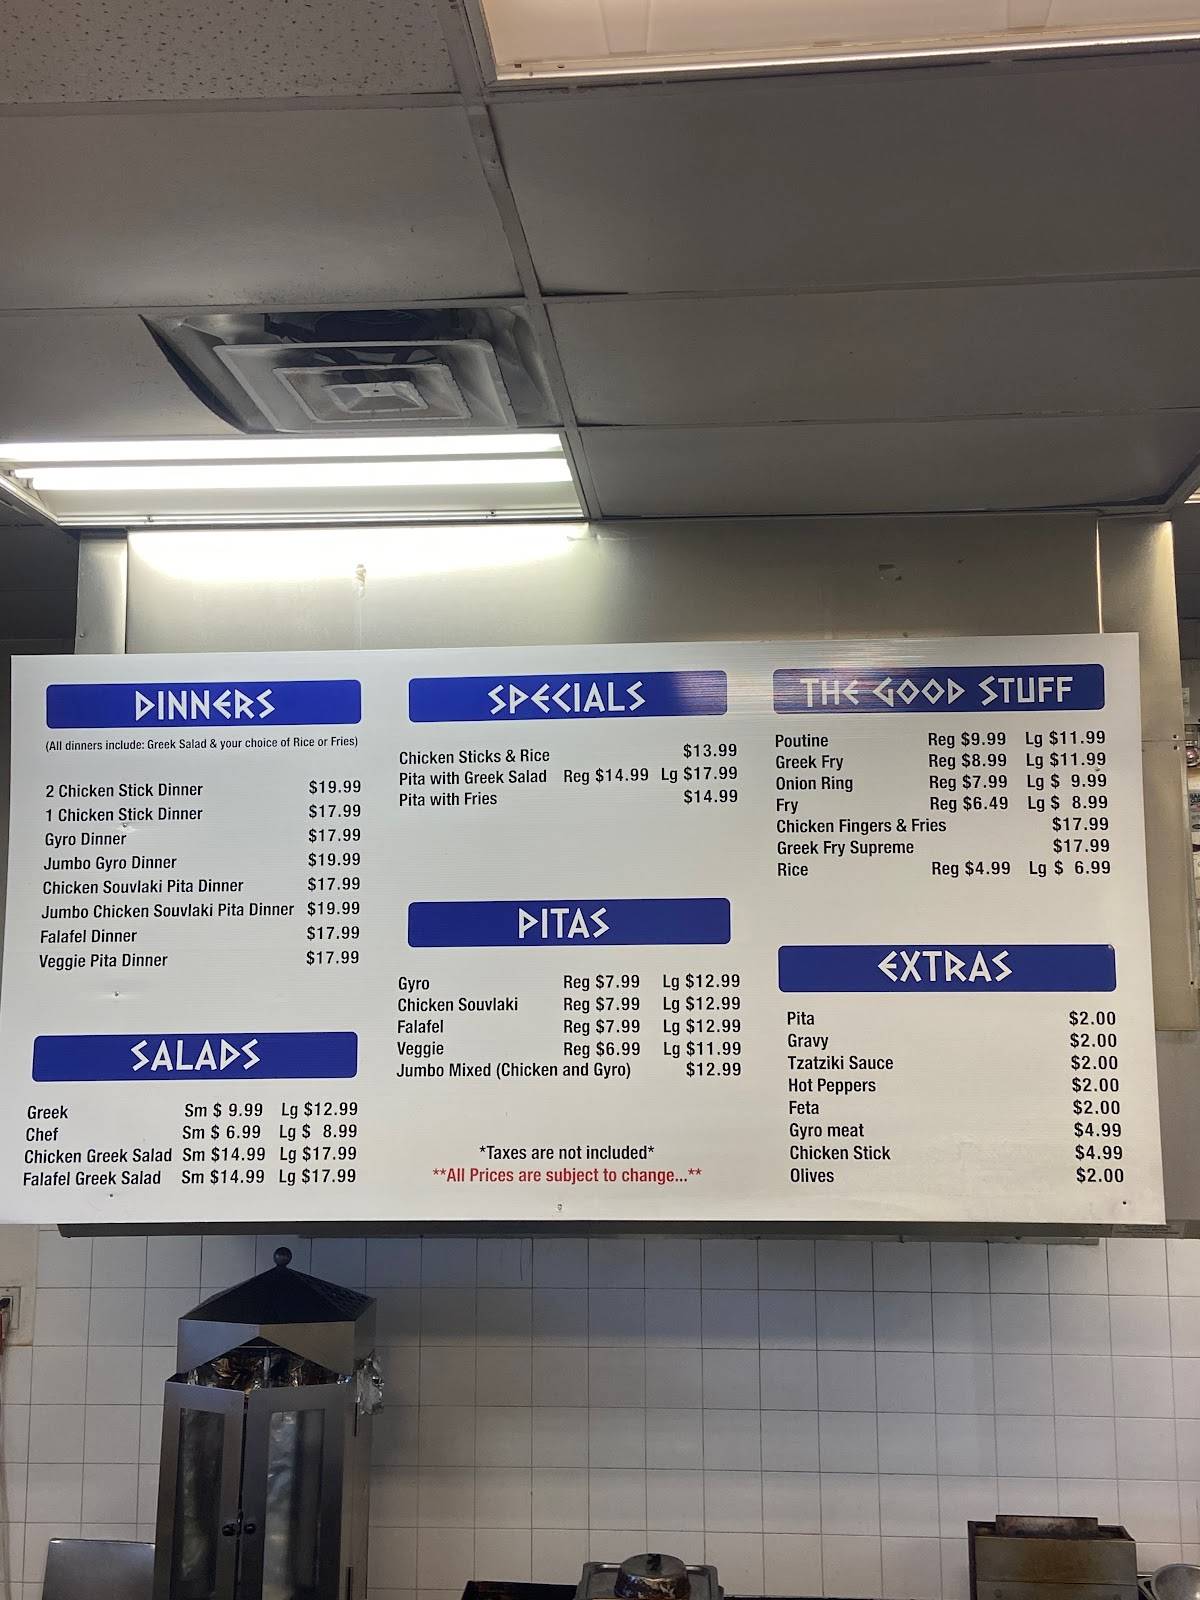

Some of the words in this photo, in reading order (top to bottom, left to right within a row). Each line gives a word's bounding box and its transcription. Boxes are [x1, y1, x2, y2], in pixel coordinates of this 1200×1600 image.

[487, 680, 646, 715] SPECIALS
[799, 676, 861, 709] THE
[872, 675, 967, 708] GOOD
[977, 675, 1075, 707] STUFF
[135, 688, 275, 721] DINNERS
[45, 740, 62, 753] (All
[64, 740, 103, 751] dinners
[105, 739, 144, 750] include:
[146, 738, 176, 750] Greek
[178, 738, 207, 749] Salad
[209, 738, 217, 749] &
[219, 739, 242, 750] your
[244, 737, 277, 748] choice
[280, 737, 290, 747] of
[293, 736, 315, 747] Rice
[317, 738, 328, 747] or
[330, 735, 358, 748] Fries)
[775, 733, 829, 748] Poutine
[927, 732, 955, 749] Reg
[960, 730, 1006, 747] $9.99
[1025, 731, 1043, 748] Lg
[1048, 729, 1105, 746] $11.99
[399, 750, 454, 765] Chicken
[458, 749, 501, 764] Sticks
[505, 748, 516, 763] &
[520, 748, 550, 762] Rice
[683, 742, 737, 759] $13.99
[775, 754, 817, 769] Greek
[821, 754, 844, 771] Fry
[928, 753, 956, 770] Reg
[961, 752, 1007, 768] $8.99
[1026, 752, 1043, 770] Lg
[1049, 751, 1106, 768] $11.99
[399, 772, 425, 786] Pita
[429, 770, 459, 785] with
[464, 770, 504, 784] Greek
[508, 769, 547, 783] Salad
[563, 769, 590, 785] Reg
[595, 767, 649, 783] $14.99
[661, 767, 678, 784] Lg
[683, 765, 737, 781] $17.99
[45, 784, 54, 798] 2
[58, 783, 114, 798] Chicken
[118, 783, 154, 797] Stick
[158, 782, 203, 796] Dinner
[308, 779, 361, 794] $19.99
[399, 792, 425, 807] Pita
[429, 792, 459, 806] with
[464, 791, 497, 805] Fries
[683, 788, 738, 804] $14.99
[45, 808, 51, 822] 1
[58, 807, 113, 822] Chicken
[118, 807, 153, 821] Stick
[157, 806, 203, 820] Dinner
[308, 803, 361, 819] $17.99
[776, 818, 834, 833] Chicken
[838, 818, 892, 836] Fingers
[895, 818, 907, 832] &
[911, 817, 946, 832] Fries
[1051, 816, 1108, 832] $17.99
[44, 832, 76, 849] Gyro
[80, 831, 127, 845] Dinner
[308, 827, 361, 843] $17.99
[777, 840, 819, 855] Greek
[823, 840, 845, 857] Fry
[849, 839, 914, 857] Supreme
[1052, 837, 1110, 854] $17.99
[43, 856, 91, 870] Jumbo
[95, 855, 127, 872] Gyro
[131, 855, 177, 869] Dinner
[307, 851, 360, 867] $19.99
[42, 880, 98, 895] Chicken
[102, 879, 162, 894] Souvlaki
[167, 878, 193, 893] Pita
[198, 878, 244, 892] Dinner
[307, 876, 360, 892] $17.99
[41, 904, 89, 919] Jumbo
[93, 904, 149, 918] Chicken
[153, 903, 213, 917] Souvlaki
[217, 902, 244, 916] Pita
[249, 901, 295, 916] Dinner
[306, 900, 360, 917] $19.99
[518, 907, 610, 939] PITAS
[40, 929, 86, 944] Falafel
[91, 928, 137, 943] Dinner
[306, 925, 359, 941] $17.99
[39, 953, 86, 971] Veggie
[90, 953, 117, 967] Pita
[121, 952, 168, 967] Dinner
[305, 949, 359, 966] $17.99
[877, 949, 1012, 982] EXTRAS
[398, 976, 429, 993] Gyro
[563, 974, 589, 992] Reg
[595, 974, 639, 989] $7.99
[663, 973, 679, 991] Lg
[685, 972, 740, 989] $12.99
[397, 997, 454, 1012] Chicken
[458, 996, 518, 1011] Souvlaki
[563, 997, 589, 1014] Reg
[595, 996, 640, 1012] $7.99
[663, 996, 680, 1014] Lg
[685, 995, 740, 1011] $12.99
[396, 1040, 444, 1058] Veggie
[563, 1041, 590, 1059] Reg
[595, 1040, 640, 1057] $6.99
[663, 1041, 680, 1059] Lg
[686, 1040, 741, 1057] $11.99
[787, 1032, 829, 1051] Gravy
[1069, 1032, 1117, 1048] $2.00
[130, 1038, 260, 1071] SALADS
[787, 1055, 844, 1070] Tzatziki
[848, 1055, 893, 1070] Sauce
[1070, 1054, 1118, 1071] $2.00
[396, 1062, 444, 1077] Jumbo
[449, 1062, 491, 1077] Mixed
[496, 1061, 558, 1080] (Chicken
[562, 1061, 588, 1076] and
[593, 1061, 631, 1080] Gyro)
[685, 1060, 741, 1078] $12.99
[788, 1077, 813, 1092] Hot
[817, 1077, 876, 1095] Peppers
[1071, 1076, 1119, 1093] $2.00
[788, 1100, 819, 1115] Feta
[1072, 1098, 1120, 1115] $2.00
[789, 1122, 822, 1140] Gyro
[827, 1123, 864, 1137] meat
[1073, 1120, 1121, 1138] $4.99
[24, 1148, 81, 1164] Chicken
[86, 1148, 128, 1163] Greek
[132, 1147, 172, 1163] Salad
[182, 1147, 205, 1162] Sm
[210, 1146, 265, 1162] $14.99
[279, 1146, 296, 1164] Lg
[302, 1145, 356, 1162] $17.99
[531, 1148, 554, 1160] are
[558, 1145, 582, 1160] not
[789, 1145, 848, 1160] Chicken
[853, 1145, 891, 1160] Stick
[1074, 1143, 1123, 1161] $4.99
[469, 1167, 514, 1182] Prices
[518, 1170, 541, 1182] are
[545, 1167, 599, 1185] subject
[602, 1167, 617, 1182] to
[790, 1167, 834, 1183] Olives
[1076, 1165, 1124, 1184] $2.00
